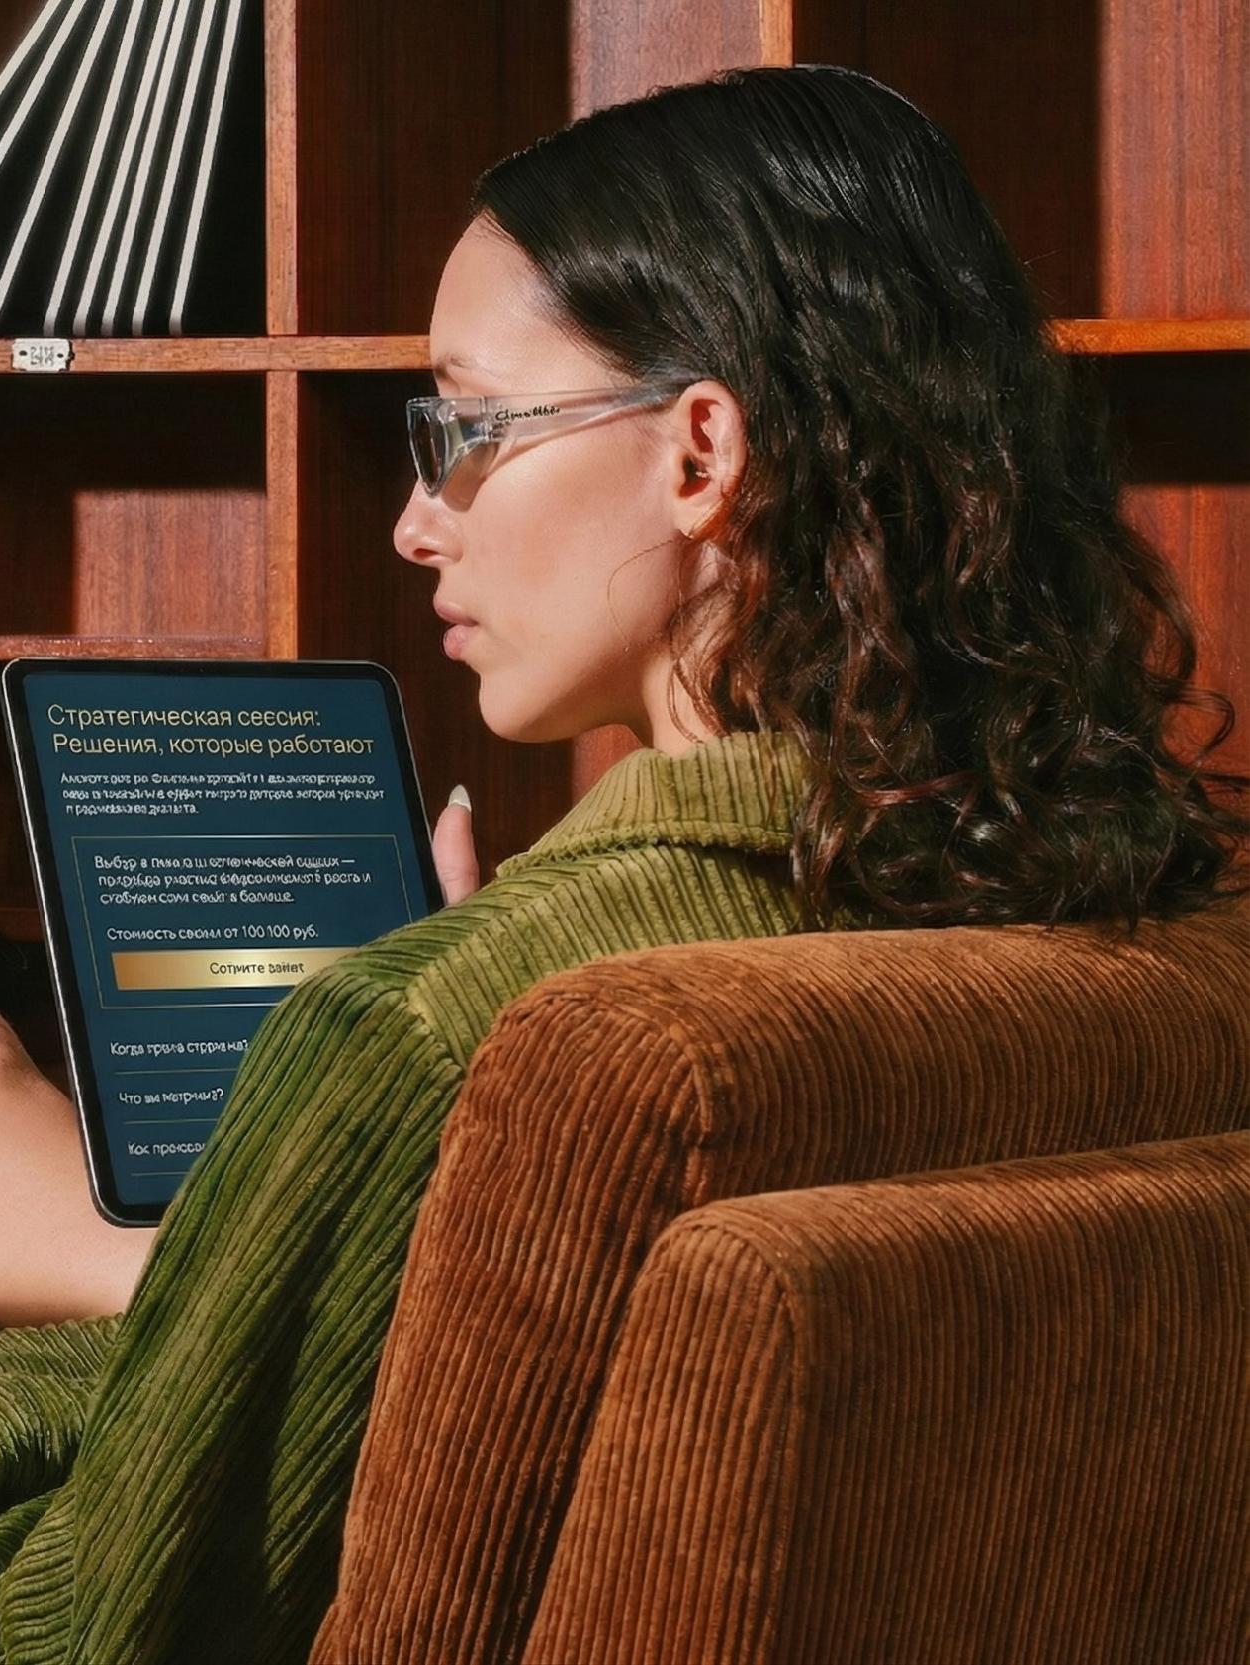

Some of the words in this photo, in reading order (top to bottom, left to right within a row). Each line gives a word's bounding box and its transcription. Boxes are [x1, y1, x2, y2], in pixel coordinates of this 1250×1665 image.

[47, 704, 231, 730] Стратегическая
[53, 733, 164, 756] Решения,
[170, 738, 263, 758] которые
[268, 734, 375, 758] работают
[242, 925, 265, 938] 100
[267, 925, 291, 938] 100
[293, 924, 319, 941] руб.
